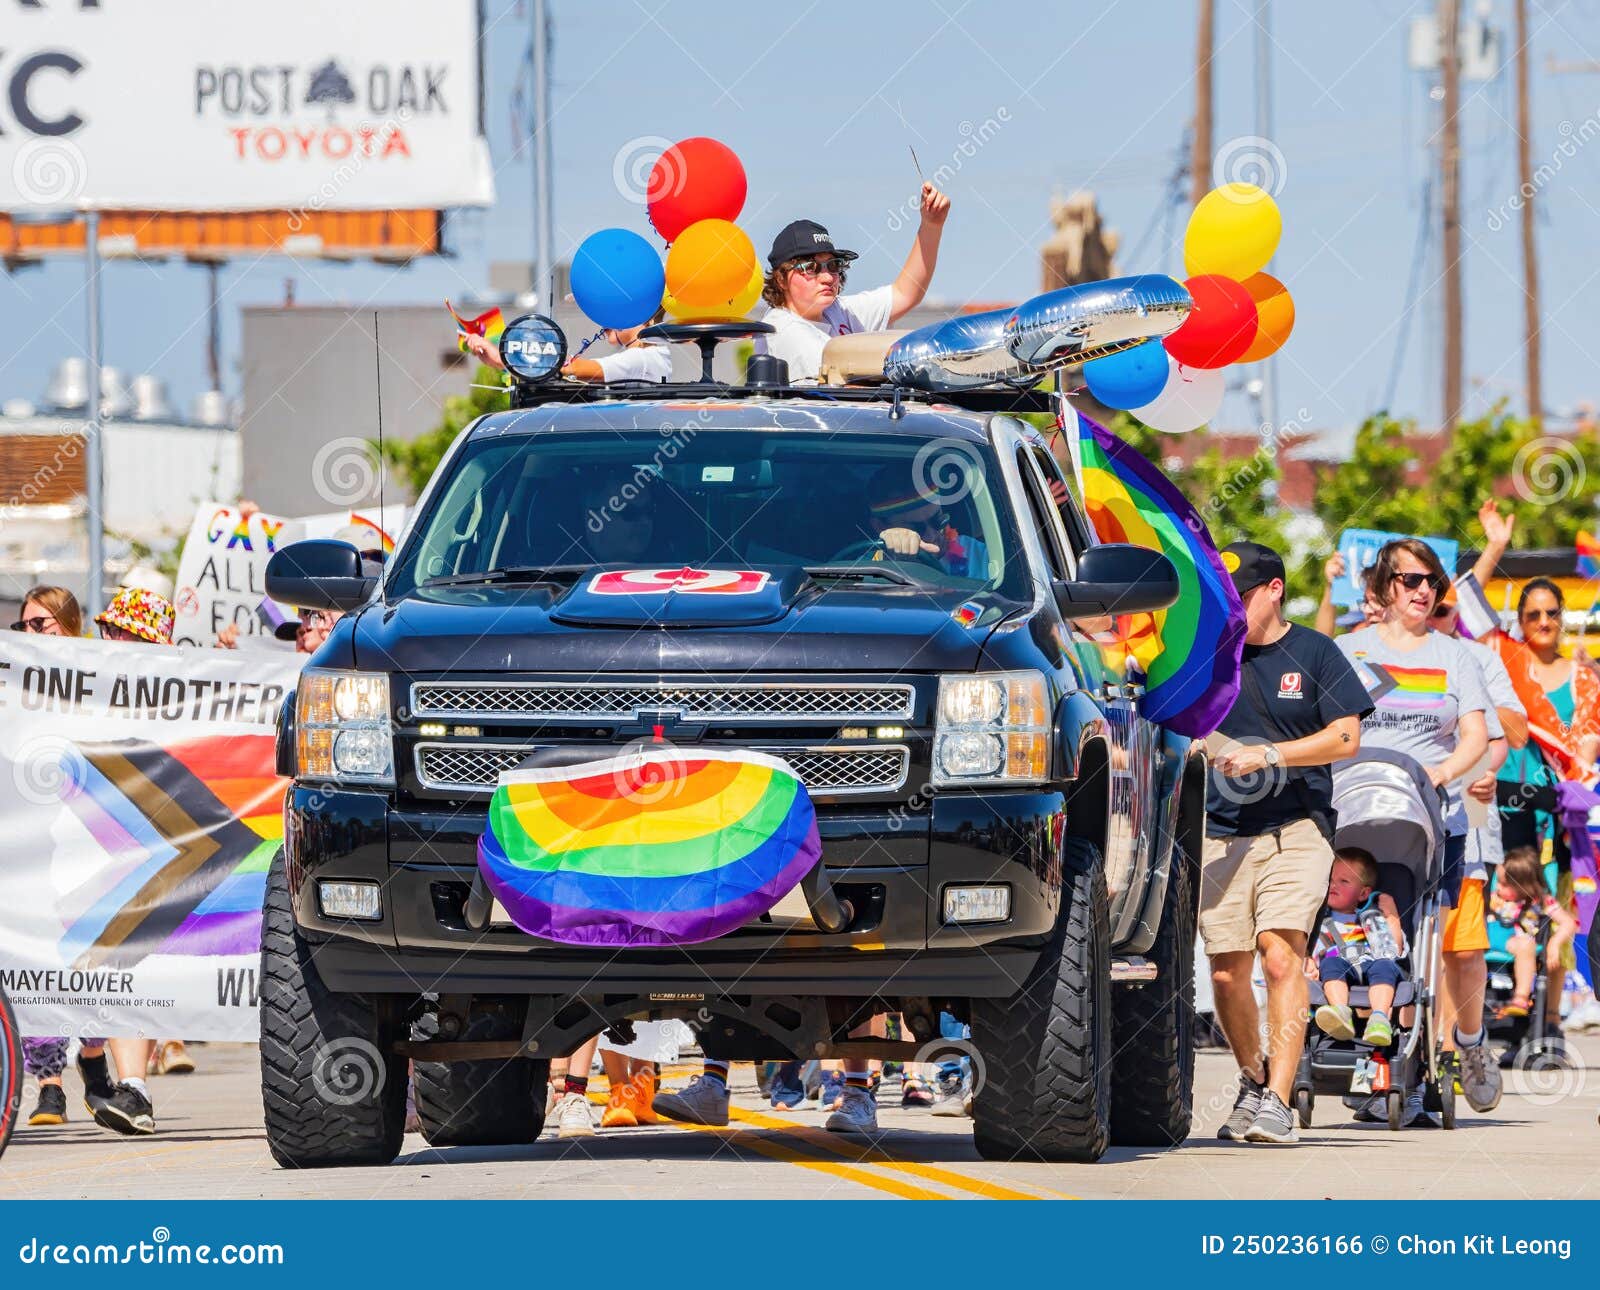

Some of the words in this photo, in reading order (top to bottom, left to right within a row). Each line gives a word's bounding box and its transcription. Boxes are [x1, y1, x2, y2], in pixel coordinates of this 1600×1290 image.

[194, 66, 296, 116] POST
[368, 66, 448, 114] OAK
[227, 126, 412, 160] TOYOTA
[507, 340, 558, 356] PIAA
[208, 509, 284, 553] GAY
[21, 664, 97, 716] ONE
[105, 673, 284, 725] ANOTHER
[0, 969, 134, 993] MAYFLOWER
[8, 996, 66, 1006] NGREGATIONAL
[69, 997, 97, 1006] UNITED
[100, 998, 131, 1007] CHURCH
[134, 999, 144, 1007] OF
[147, 999, 176, 1007] CHRIST
